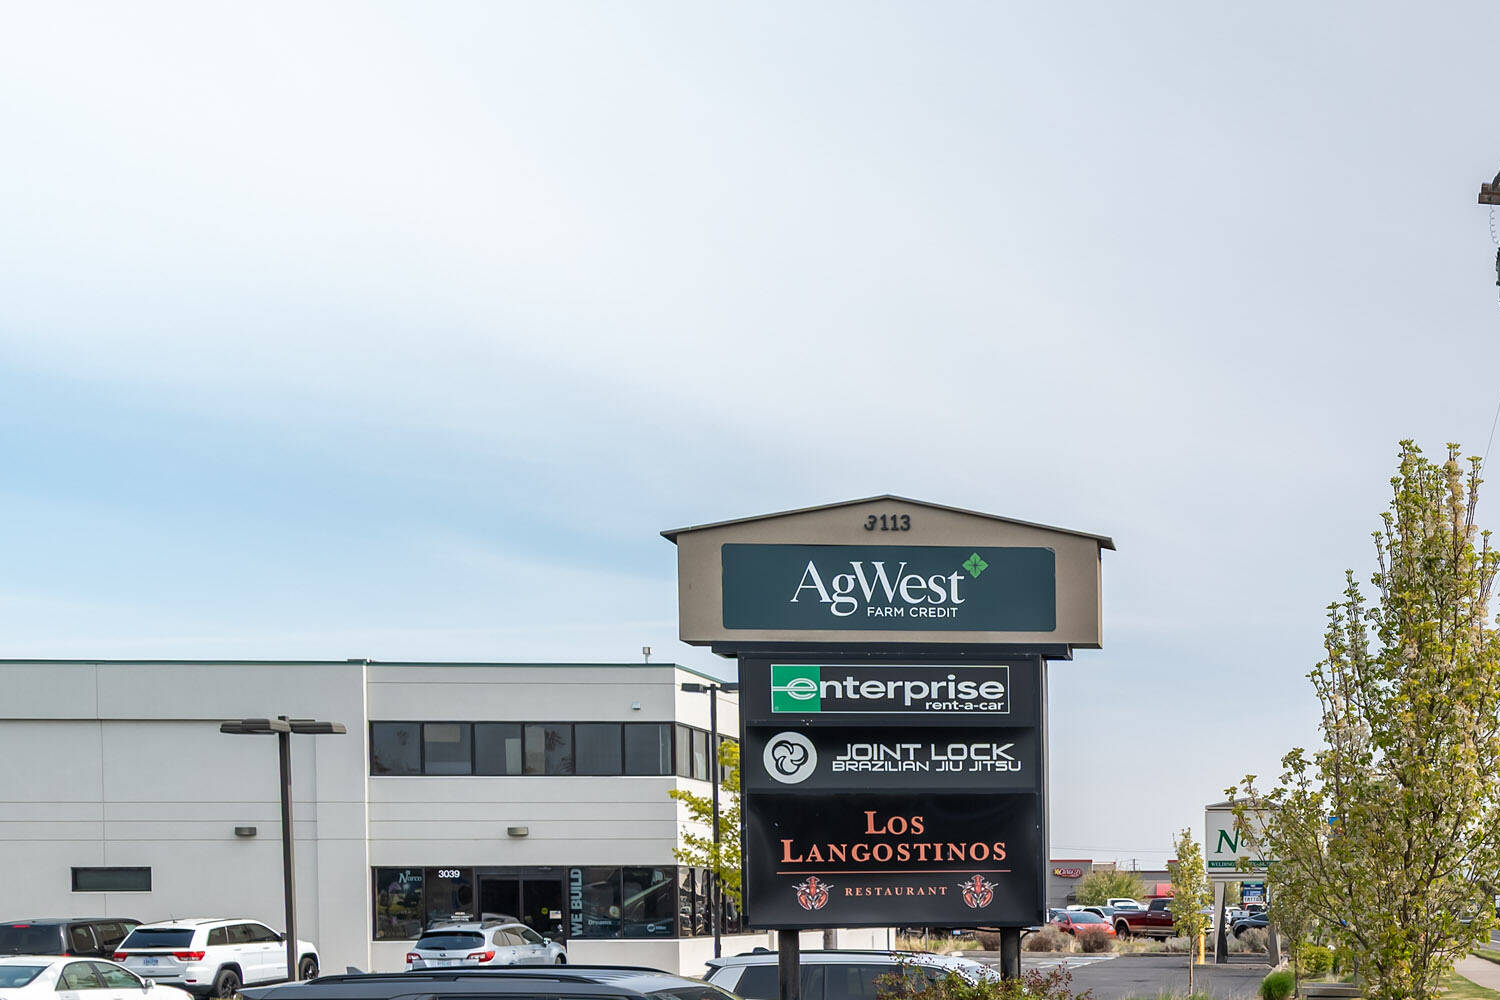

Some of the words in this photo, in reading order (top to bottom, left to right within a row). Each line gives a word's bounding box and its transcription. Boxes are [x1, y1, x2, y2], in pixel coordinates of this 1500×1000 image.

[864, 514, 911, 531] 3113
[790, 560, 966, 617] AgWest
[867, 606, 904, 617] FARM
[909, 607, 958, 618] CREDIT
[785, 674, 1005, 706] enterprise
[925, 700, 1005, 711] rent-a-car
[836, 743, 922, 761] JOINT
[931, 743, 1015, 761] LOCK
[832, 761, 930, 772] BRAZILIAN
[935, 761, 963, 772] JIU
[968, 761, 1022, 772] JITSU
[780, 839, 1007, 863] LANGOSTINOS
[438, 870, 461, 879] 3039
[570, 868, 583, 910] BUILD
[845, 887, 948, 898] RESTAURANT
[571, 912, 583, 936] WE
